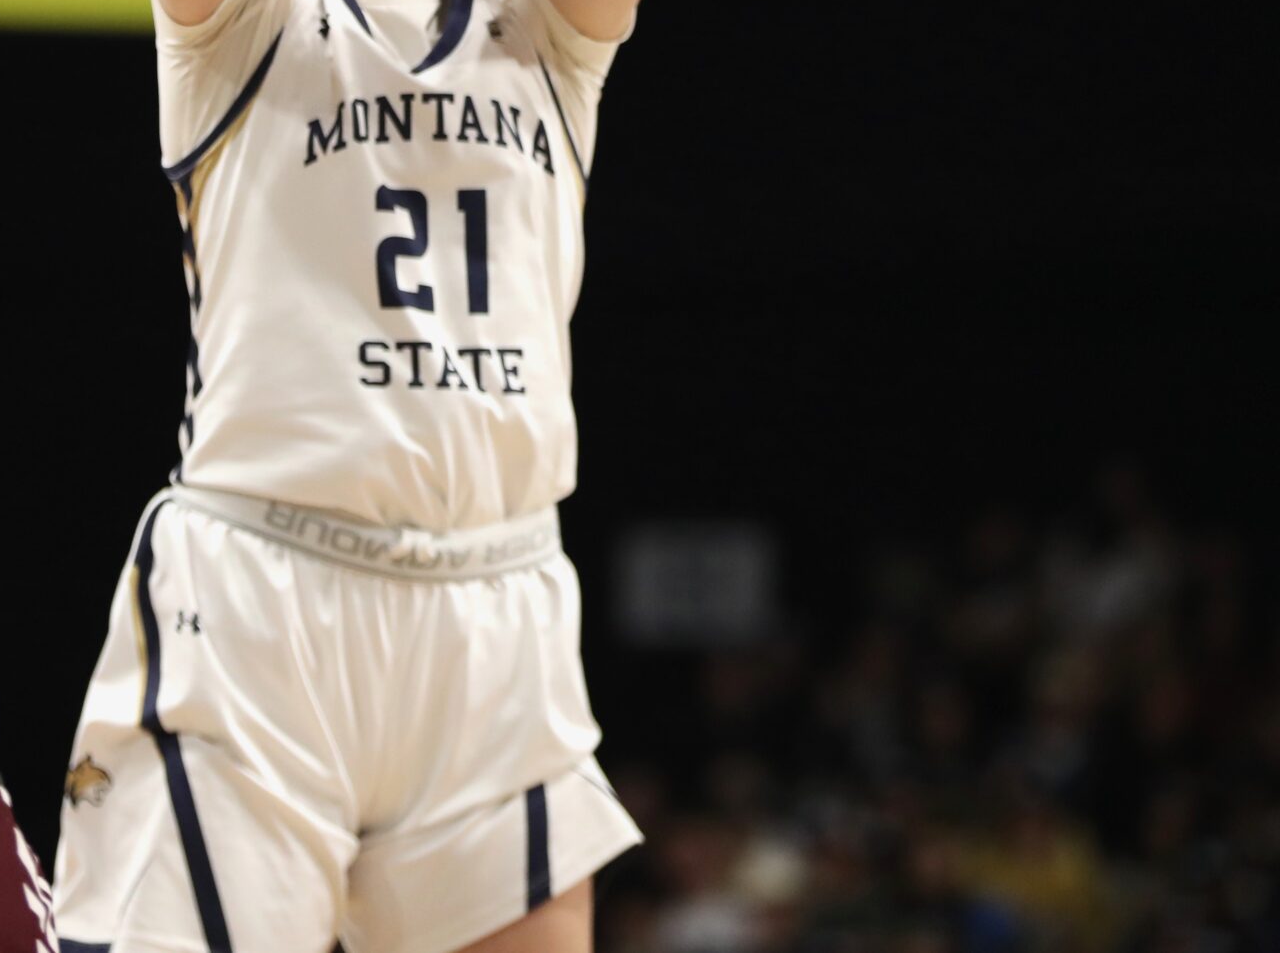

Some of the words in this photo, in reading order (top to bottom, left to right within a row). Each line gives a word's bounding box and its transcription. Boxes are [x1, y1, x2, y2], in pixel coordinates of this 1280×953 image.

[304, 93, 555, 176] MONTANA
[376, 184, 489, 314] 21
[359, 341, 526, 394] STATE
